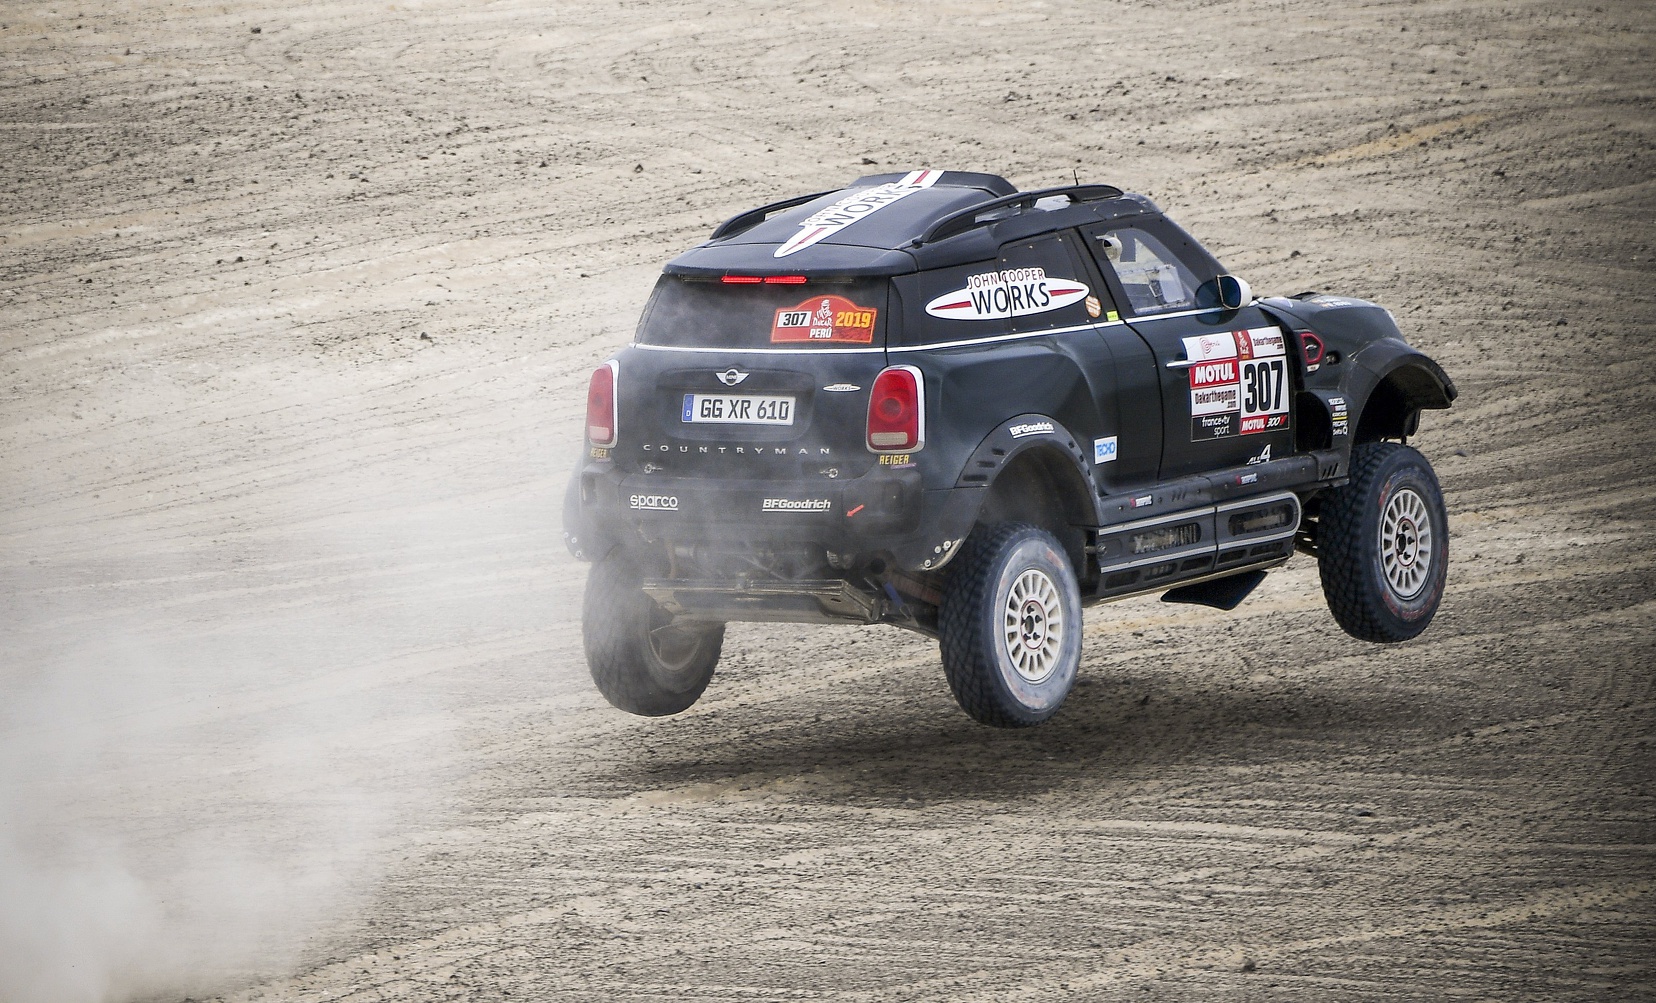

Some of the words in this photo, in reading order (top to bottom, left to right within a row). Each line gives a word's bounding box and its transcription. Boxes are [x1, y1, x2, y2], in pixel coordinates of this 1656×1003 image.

[968, 274, 998, 290] JOHN
[1000, 269, 1045, 283] COOPER
[971, 282, 1050, 315] WORKS
[783, 313, 807, 326] 307
[835, 311, 871, 328] 2019
[809, 327, 833, 339] PERÚ
[1195, 362, 1235, 384] MOTUL
[1244, 360, 1283, 413] 307
[700, 399, 723, 419] GG
[727, 399, 751, 420] XR
[757, 400, 789, 421] 610
[1009, 422, 1054, 436] BFGoodrich
[1241, 418, 1265, 431] MOTUL
[1213, 425, 1230, 439] sport
[643, 444, 830, 455] COUNTRYMAN
[879, 454, 910, 465] REIGER
[630, 494, 679, 510] sparco
[762, 498, 831, 510] BFGoodrich
